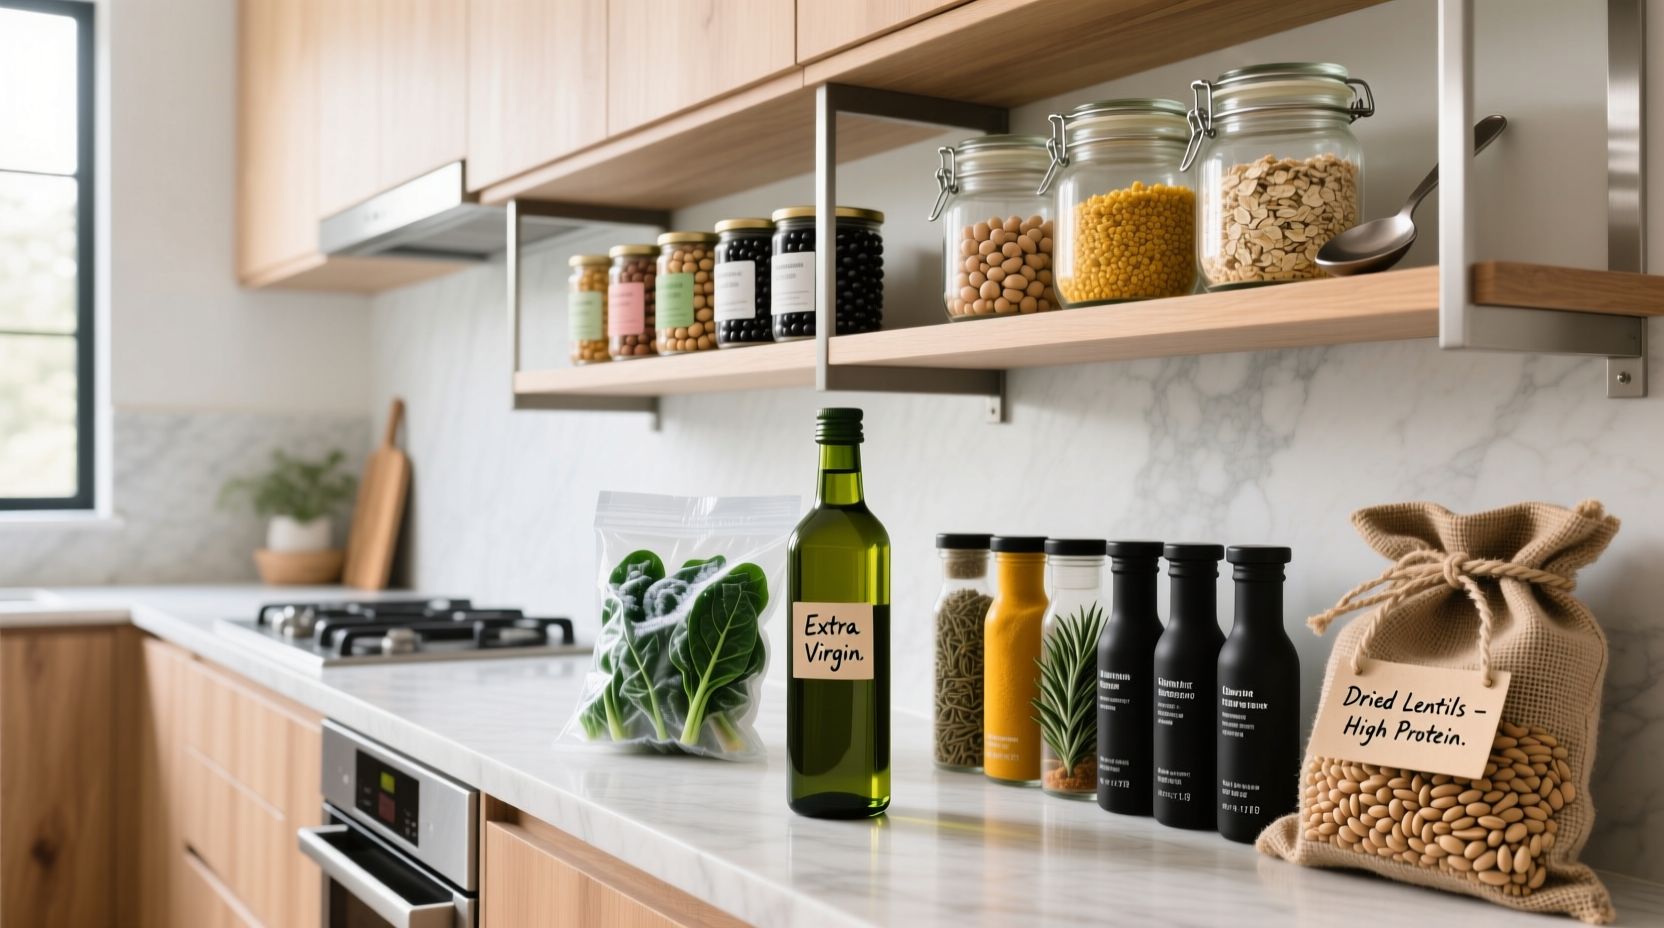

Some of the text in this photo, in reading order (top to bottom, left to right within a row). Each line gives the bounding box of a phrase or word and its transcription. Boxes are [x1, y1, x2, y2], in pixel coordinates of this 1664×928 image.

[805, 613, 861, 636] Extra
[1343, 685, 1398, 710] Dried
[1402, 692, 1467, 717] Lentils
[1343, 715, 1466, 746] High Protein.
